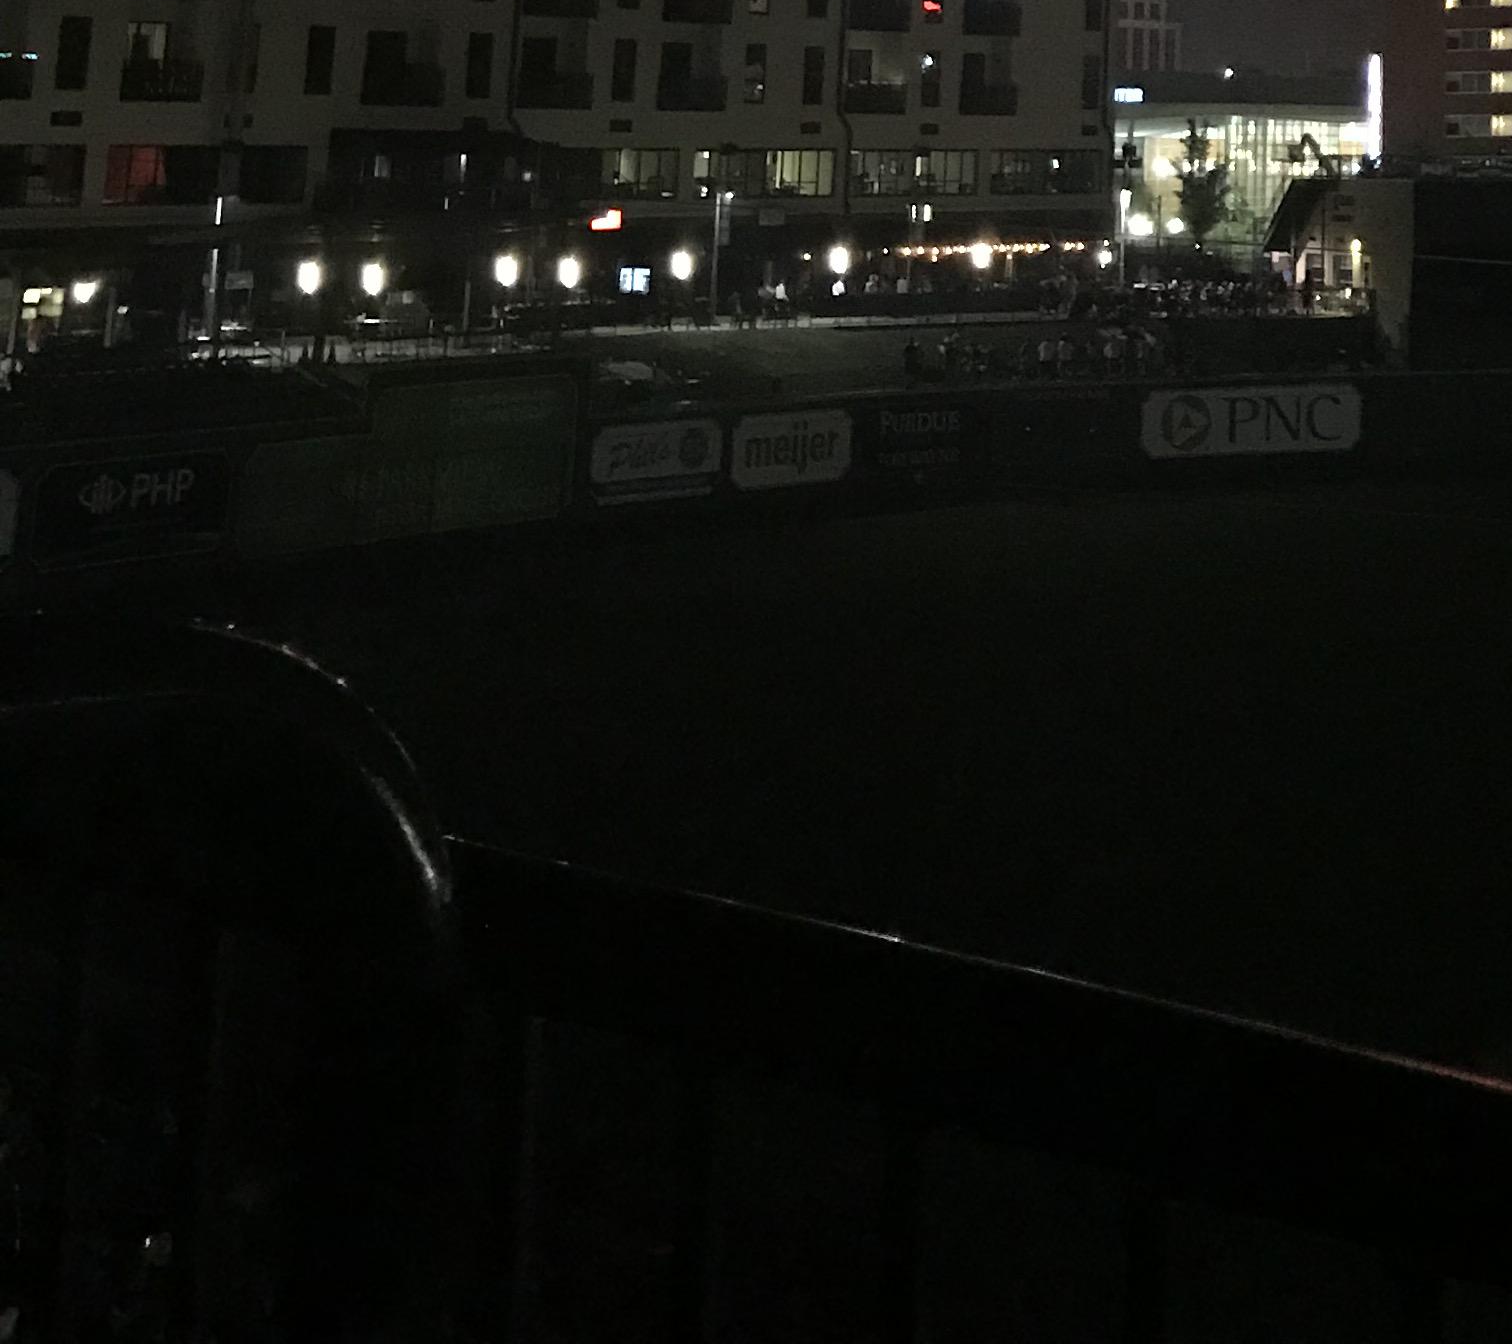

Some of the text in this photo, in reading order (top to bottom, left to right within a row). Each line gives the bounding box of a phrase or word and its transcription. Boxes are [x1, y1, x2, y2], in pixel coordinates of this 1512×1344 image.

[1220, 393, 1343, 444] PNC
[744, 419, 840, 474] meijer
[129, 468, 195, 508] PHP
